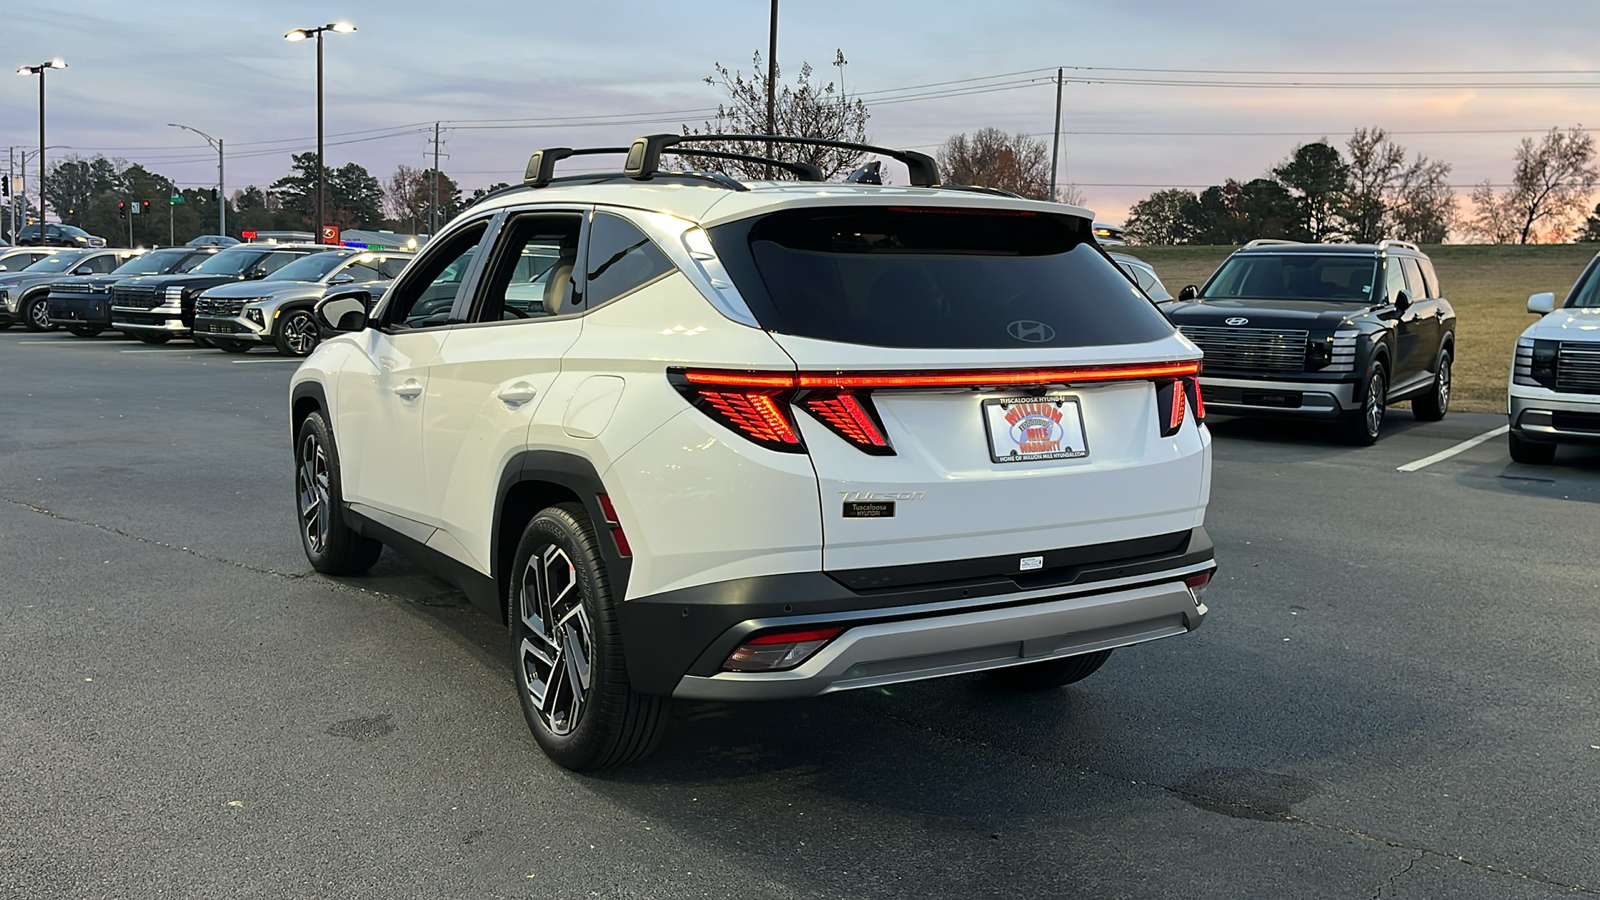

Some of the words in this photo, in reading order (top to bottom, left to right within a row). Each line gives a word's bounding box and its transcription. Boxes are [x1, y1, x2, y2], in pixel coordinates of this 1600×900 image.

[1004, 403, 1063, 427] MILLION
[1026, 427, 1050, 441] MILE
[1019, 441, 1061, 453] WARRANTY
[837, 491, 927, 501] TUCSON
